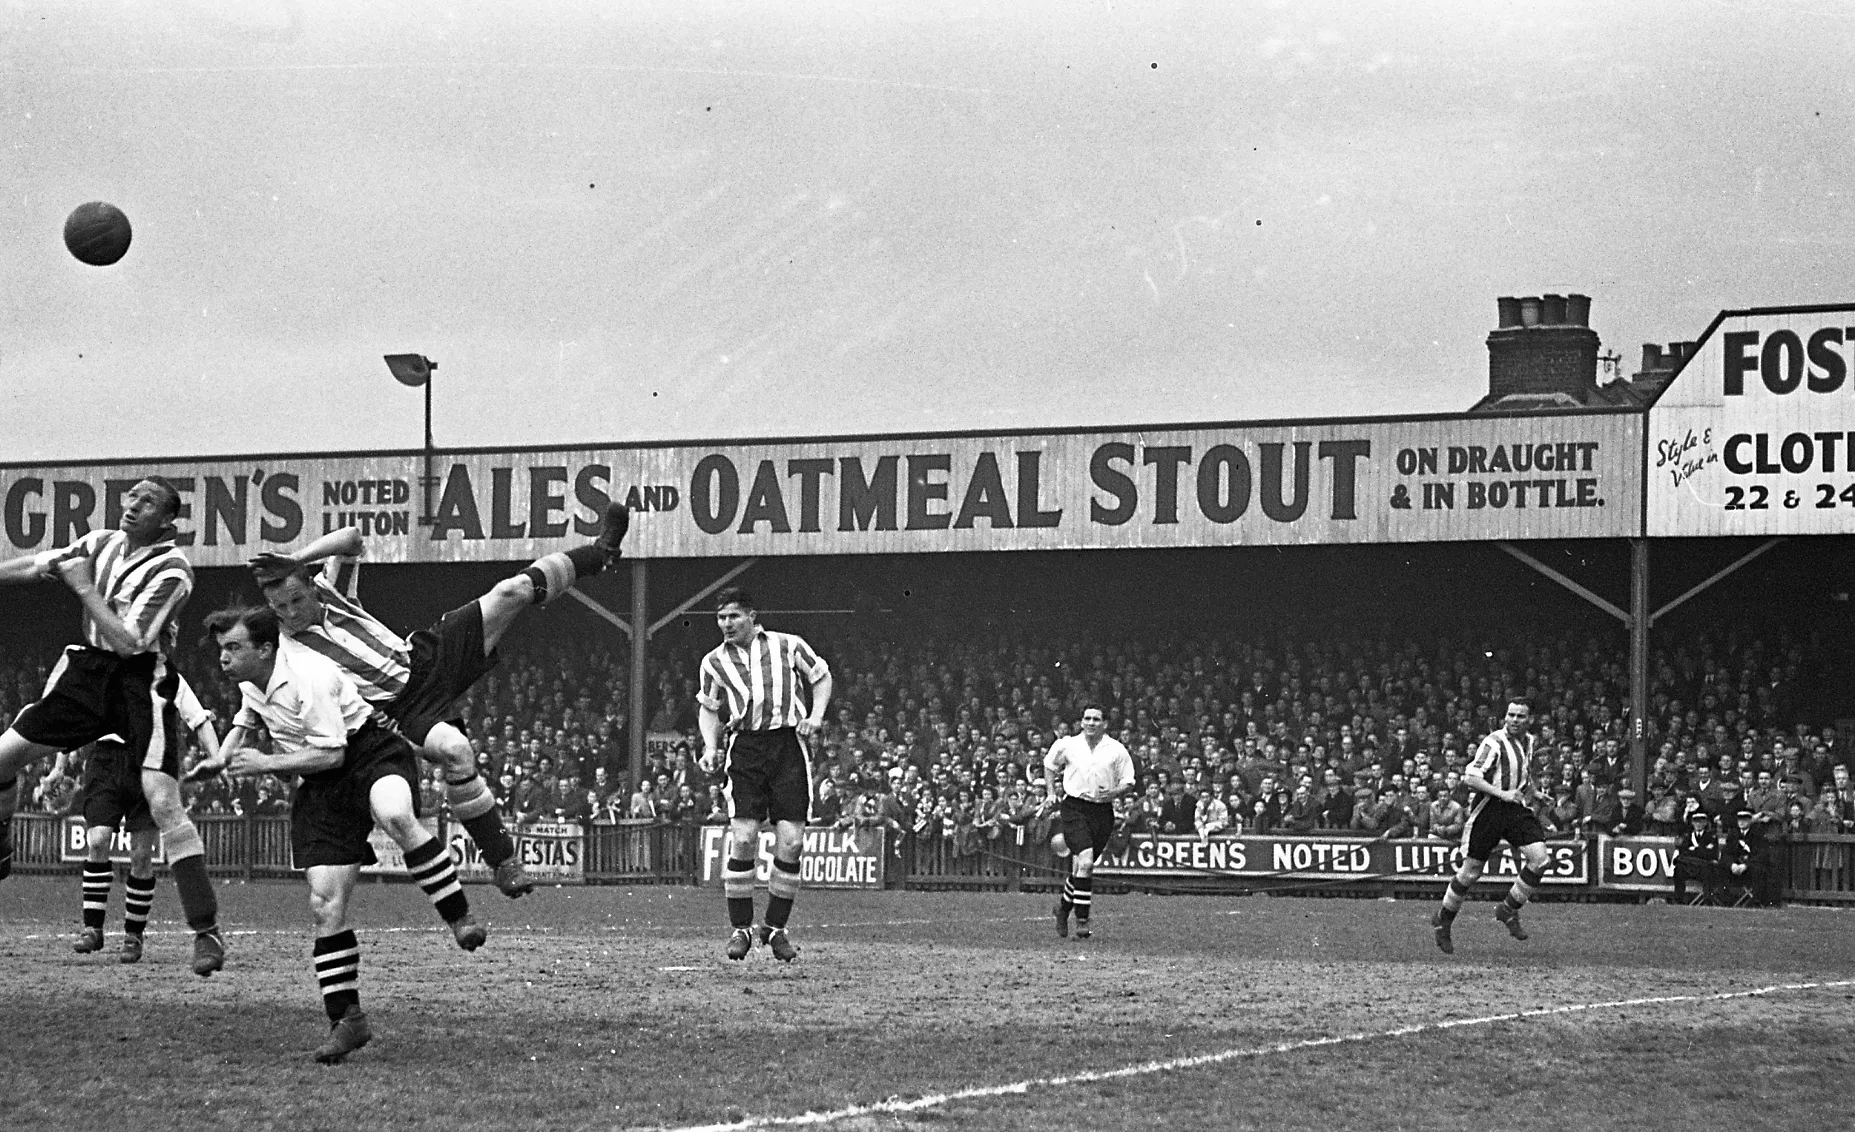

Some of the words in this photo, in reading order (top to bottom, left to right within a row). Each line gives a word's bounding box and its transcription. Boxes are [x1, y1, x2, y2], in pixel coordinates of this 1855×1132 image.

[1723, 327, 1855, 396] FOS
[1396, 447, 1438, 475] ON
[1448, 442, 1599, 474] DRAUGHT
[1657, 428, 1698, 467] Style
[323, 480, 409, 506] NOTED
[430, 463, 611, 540] ALES
[625, 485, 679, 512] AND
[690, 450, 1063, 535] OATMEAL
[1089, 439, 1371, 526] STOUT
[1390, 484, 1412, 510] &
[1423, 482, 1455, 509] IN
[1467, 478, 1605, 509] BOTTLE.
[1724, 485, 1769, 510] 22
[1783, 490, 1800, 509] &
[1273, 843, 1370, 871] NOTED
